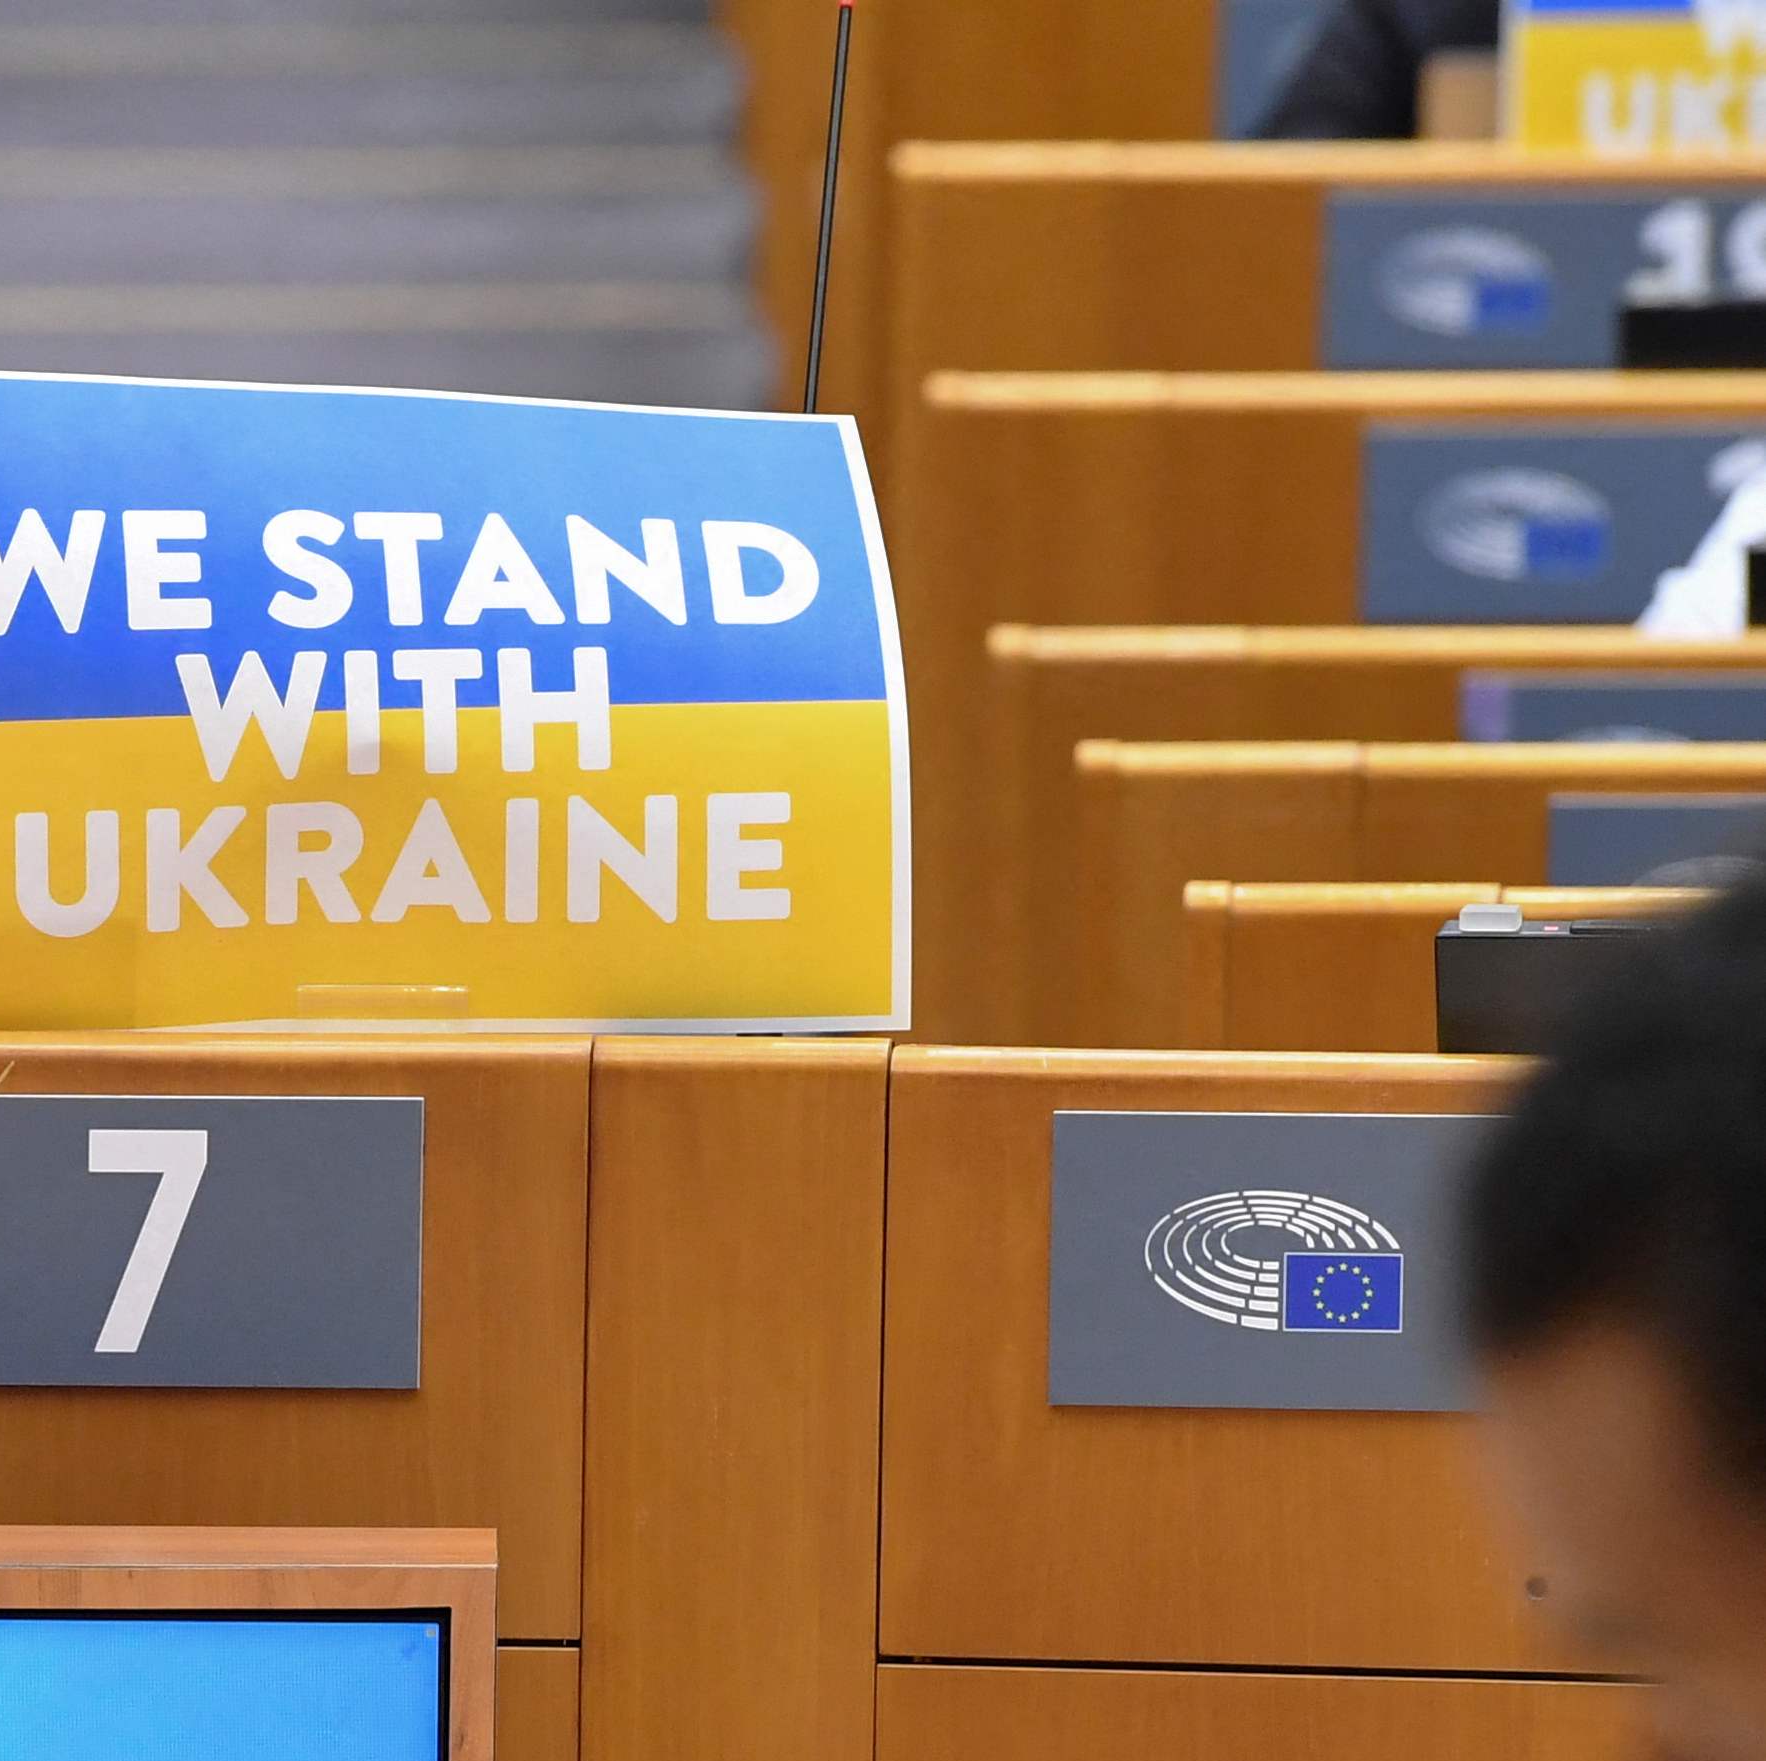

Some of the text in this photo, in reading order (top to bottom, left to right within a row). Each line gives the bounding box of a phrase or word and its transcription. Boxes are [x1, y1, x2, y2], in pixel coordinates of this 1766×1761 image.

[1581, 69, 1766, 162] UK
[263, 509, 821, 629] STAND
[175, 646, 612, 784] WITH
[14, 791, 793, 938] UKRAINE
[87, 1128, 210, 1354] 7
